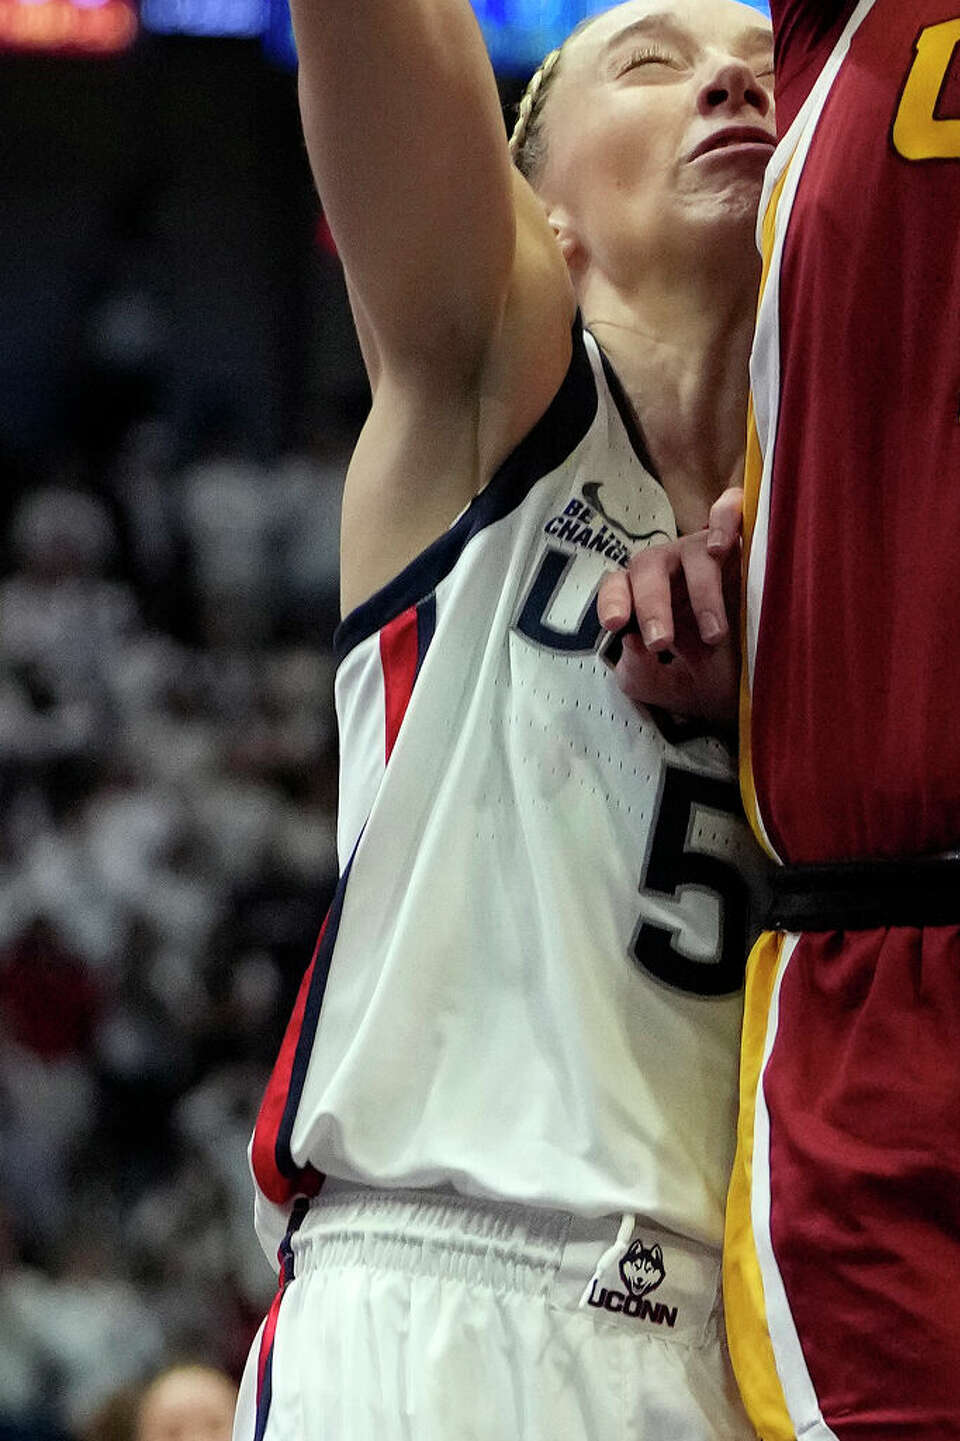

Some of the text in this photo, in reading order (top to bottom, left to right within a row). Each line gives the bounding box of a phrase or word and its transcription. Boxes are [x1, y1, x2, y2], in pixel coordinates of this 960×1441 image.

[563, 497, 595, 525] BE
[627, 760, 754, 1000] 5
[587, 1278, 678, 1328] UCONN
